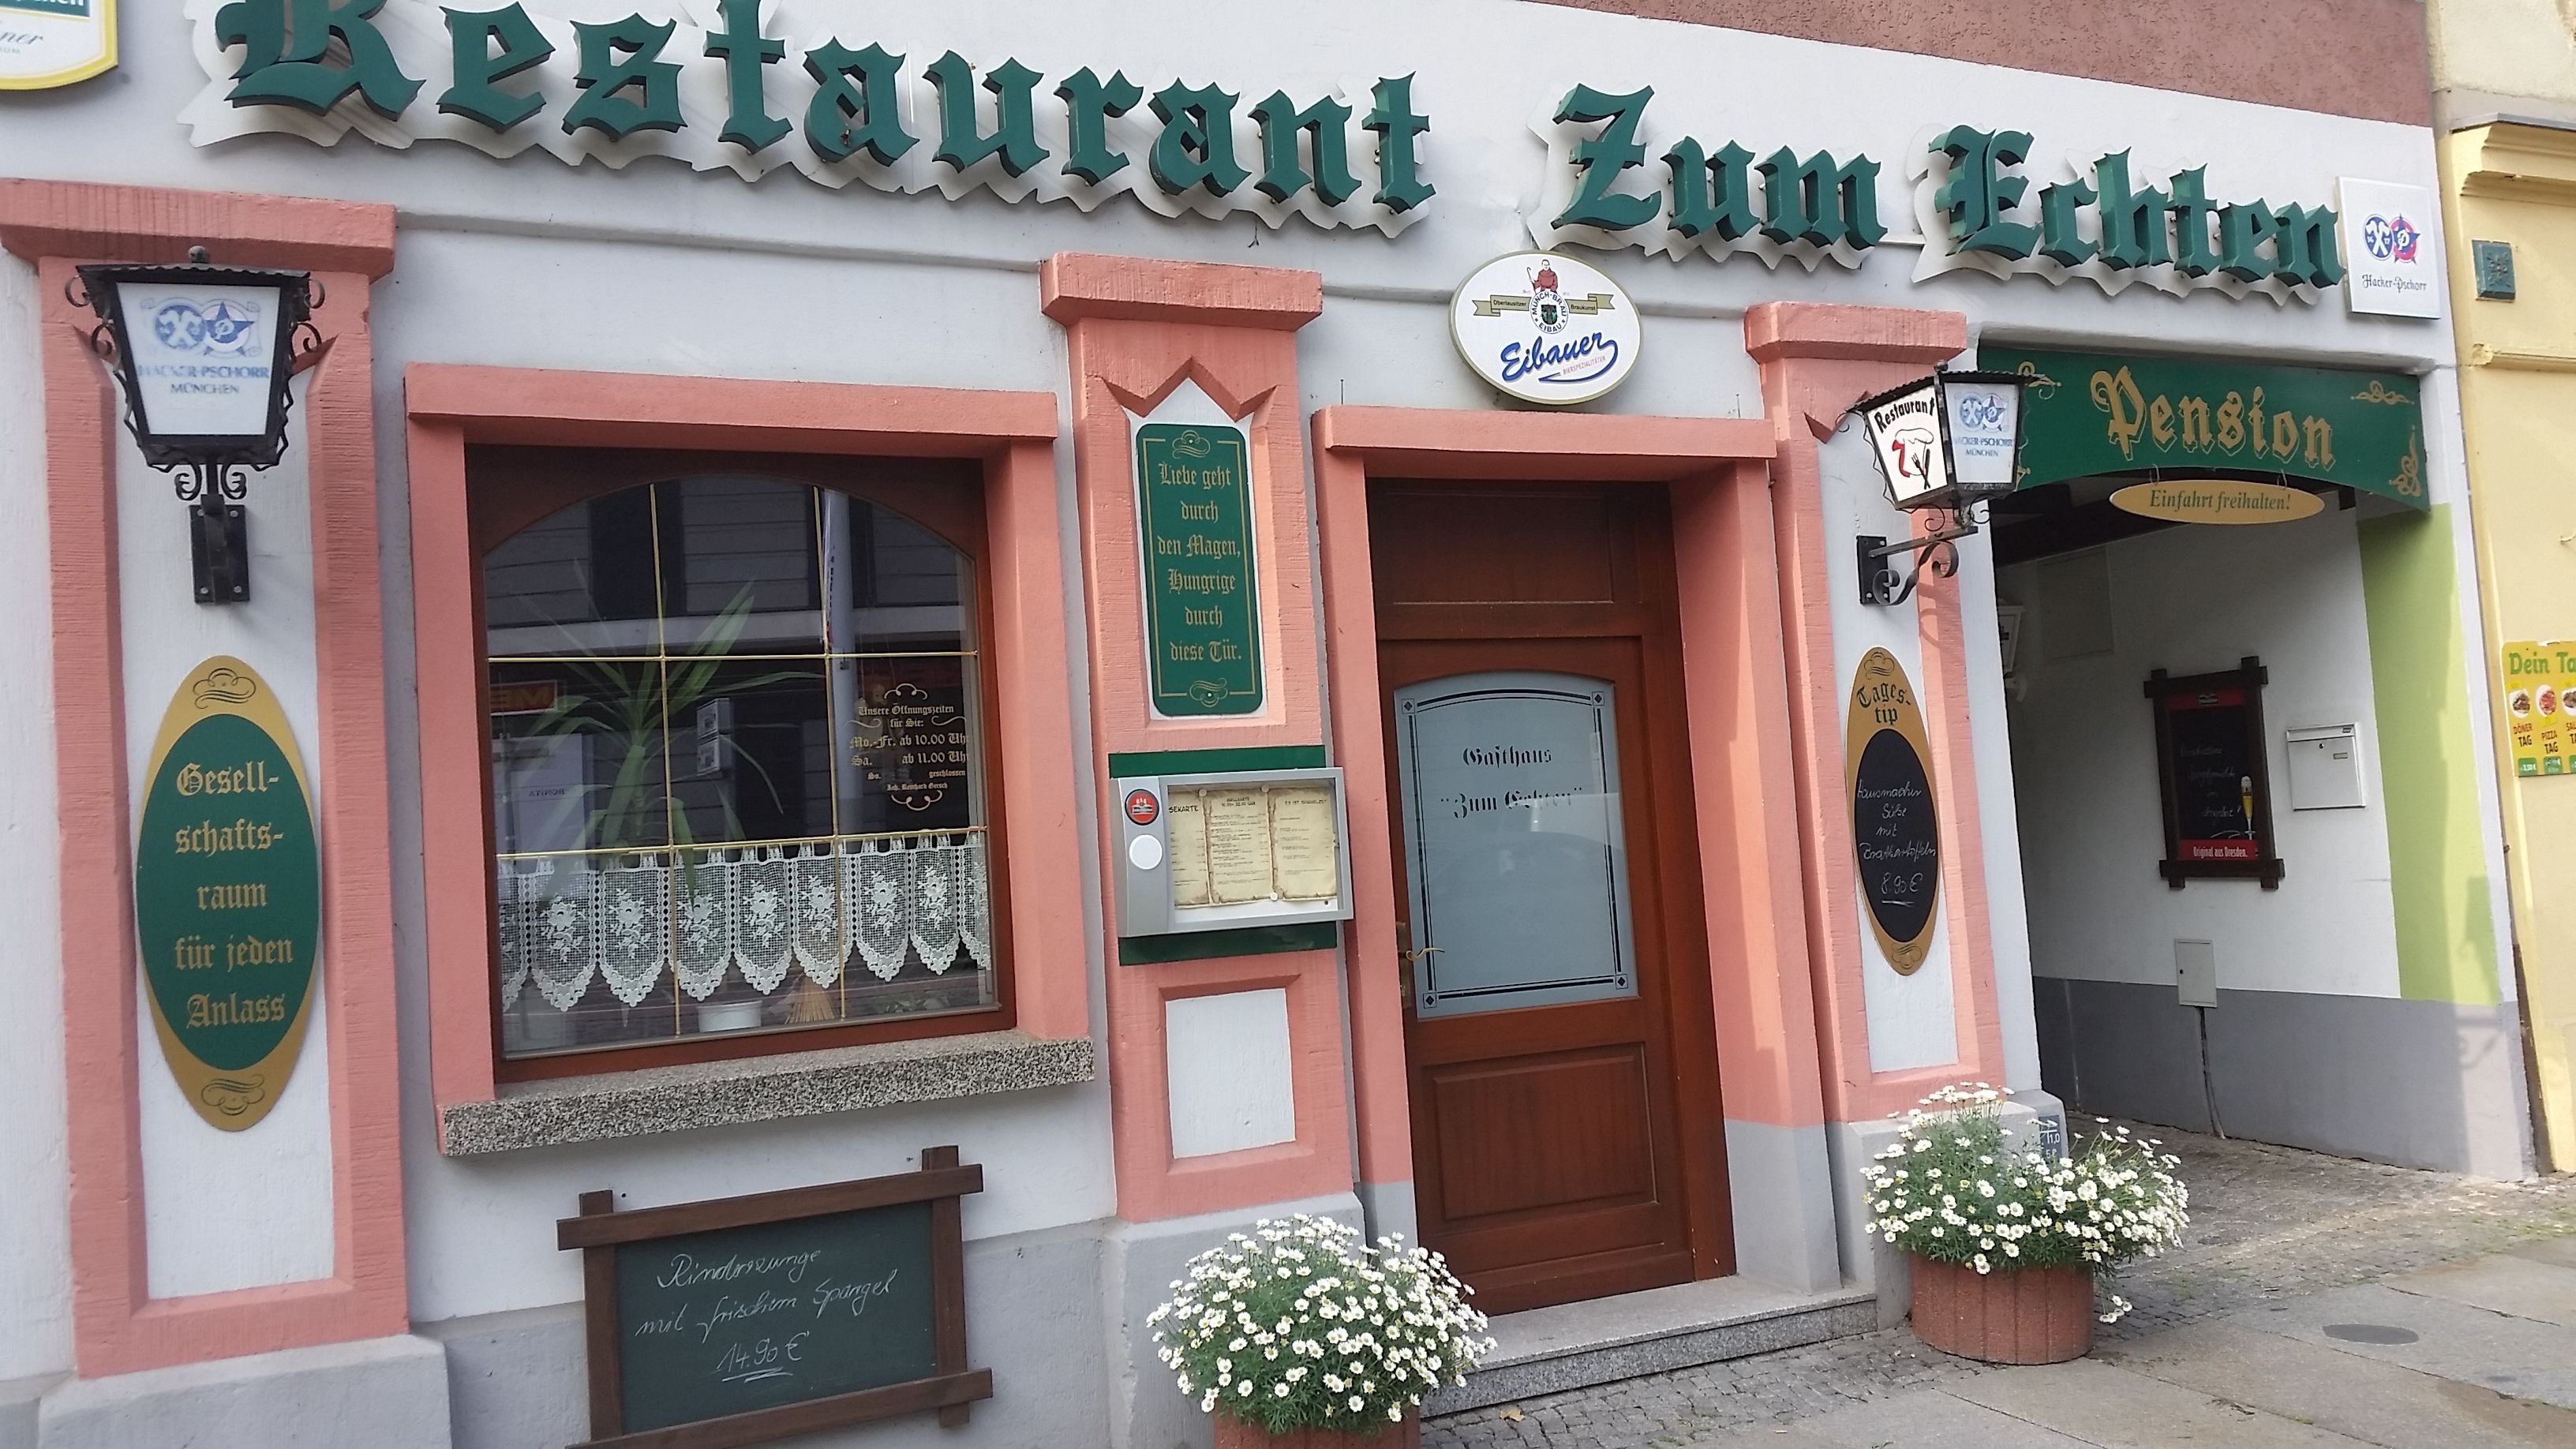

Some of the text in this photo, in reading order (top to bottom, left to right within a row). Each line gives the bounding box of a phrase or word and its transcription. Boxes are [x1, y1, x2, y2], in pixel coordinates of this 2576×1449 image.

[215, 0, 2348, 288] Restaurant Zum Echten
[2362, 274, 2427, 293] Hacker-Pschorr
[1539, 322, 1562, 332] EIBAU
[1500, 331, 1616, 382] Eibauer
[1874, 397, 1936, 434] Restaurant
[2090, 365, 2335, 472] Pension
[1158, 462, 1231, 490] Liebe geht
[1181, 500, 1219, 522] durch
[2150, 489, 2291, 513] Einfahrt freihalten!
[1158, 534, 1241, 559] den Magen,
[1168, 568, 1235, 594] Hungrige
[1185, 605, 1222, 628] durch
[1170, 639, 1241, 661] diese Tür.
[2509, 652, 2550, 675] Dein
[1856, 683, 1911, 708] Tages-
[858, 703, 954, 716] Unsere Öffnungszeiten
[1875, 704, 1898, 725] tip
[890, 717, 923, 728] für Sie:
[900, 734, 912, 746] ab
[915, 734, 945, 745] 10.00
[2518, 735, 2532, 747] TAG
[2544, 742, 2558, 754] TAG
[852, 754, 872, 766] Sa.
[902, 752, 914, 764] ab
[918, 752, 945, 763] 11.00
[177, 761, 279, 796] Gesell-
[929, 769, 965, 778] geschlossen
[175, 818, 284, 858] schafts-
[1876, 823, 1897, 837] mit
[2193, 846, 2248, 859] Original aus Dresden.
[197, 882, 268, 911] raum
[175, 934, 294, 973] für jeden
[186, 993, 285, 1029] Anlass
[635, 1304, 687, 1336] mit
